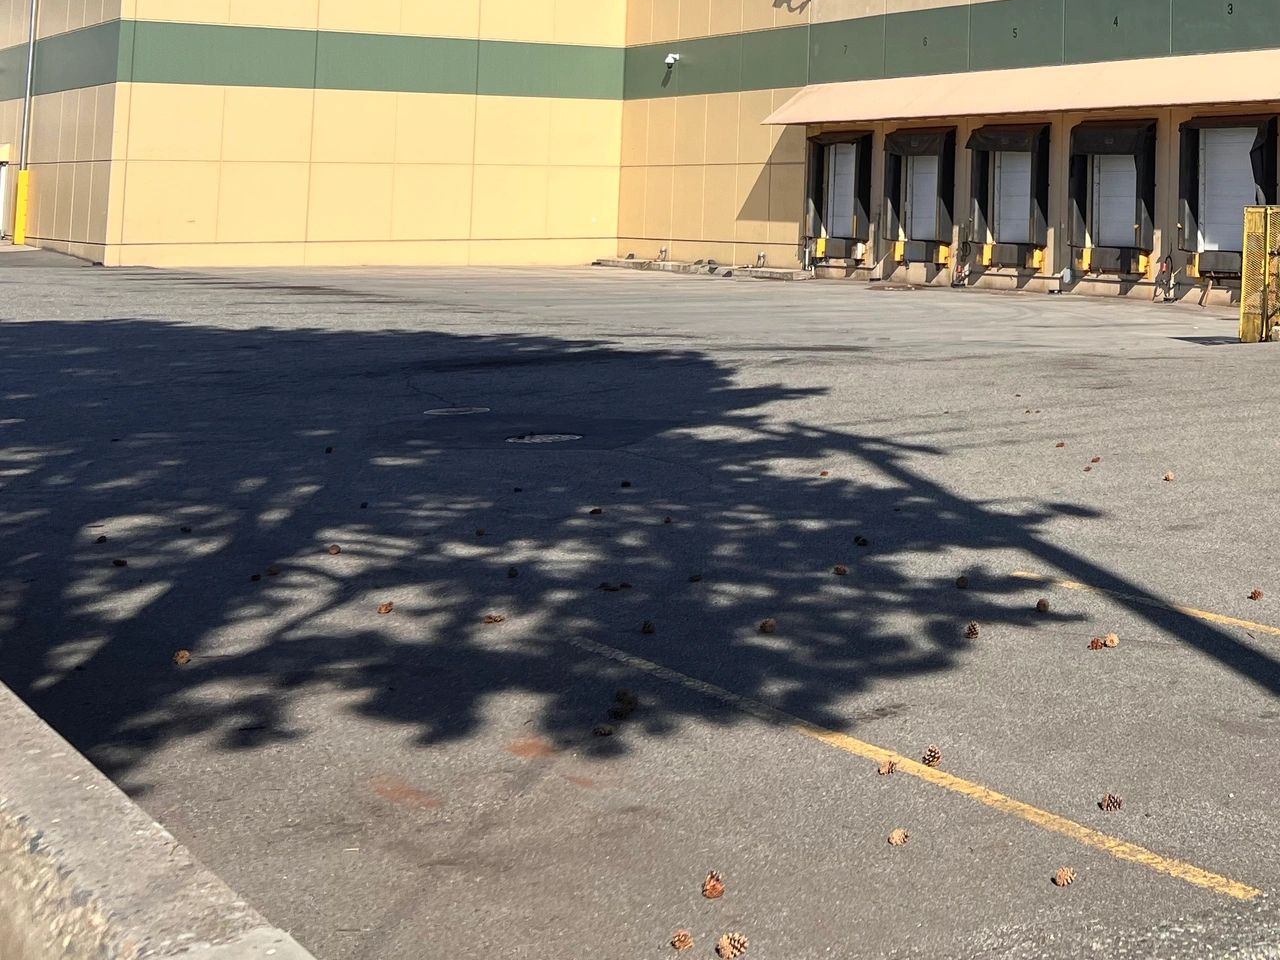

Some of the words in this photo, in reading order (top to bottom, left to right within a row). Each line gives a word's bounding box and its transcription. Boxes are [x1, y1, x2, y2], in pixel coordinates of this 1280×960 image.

[1227, 3, 1234, 15] 3
[1112, 16, 1119, 28] 4
[1012, 28, 1018, 39] 5
[922, 36, 928, 47] 6
